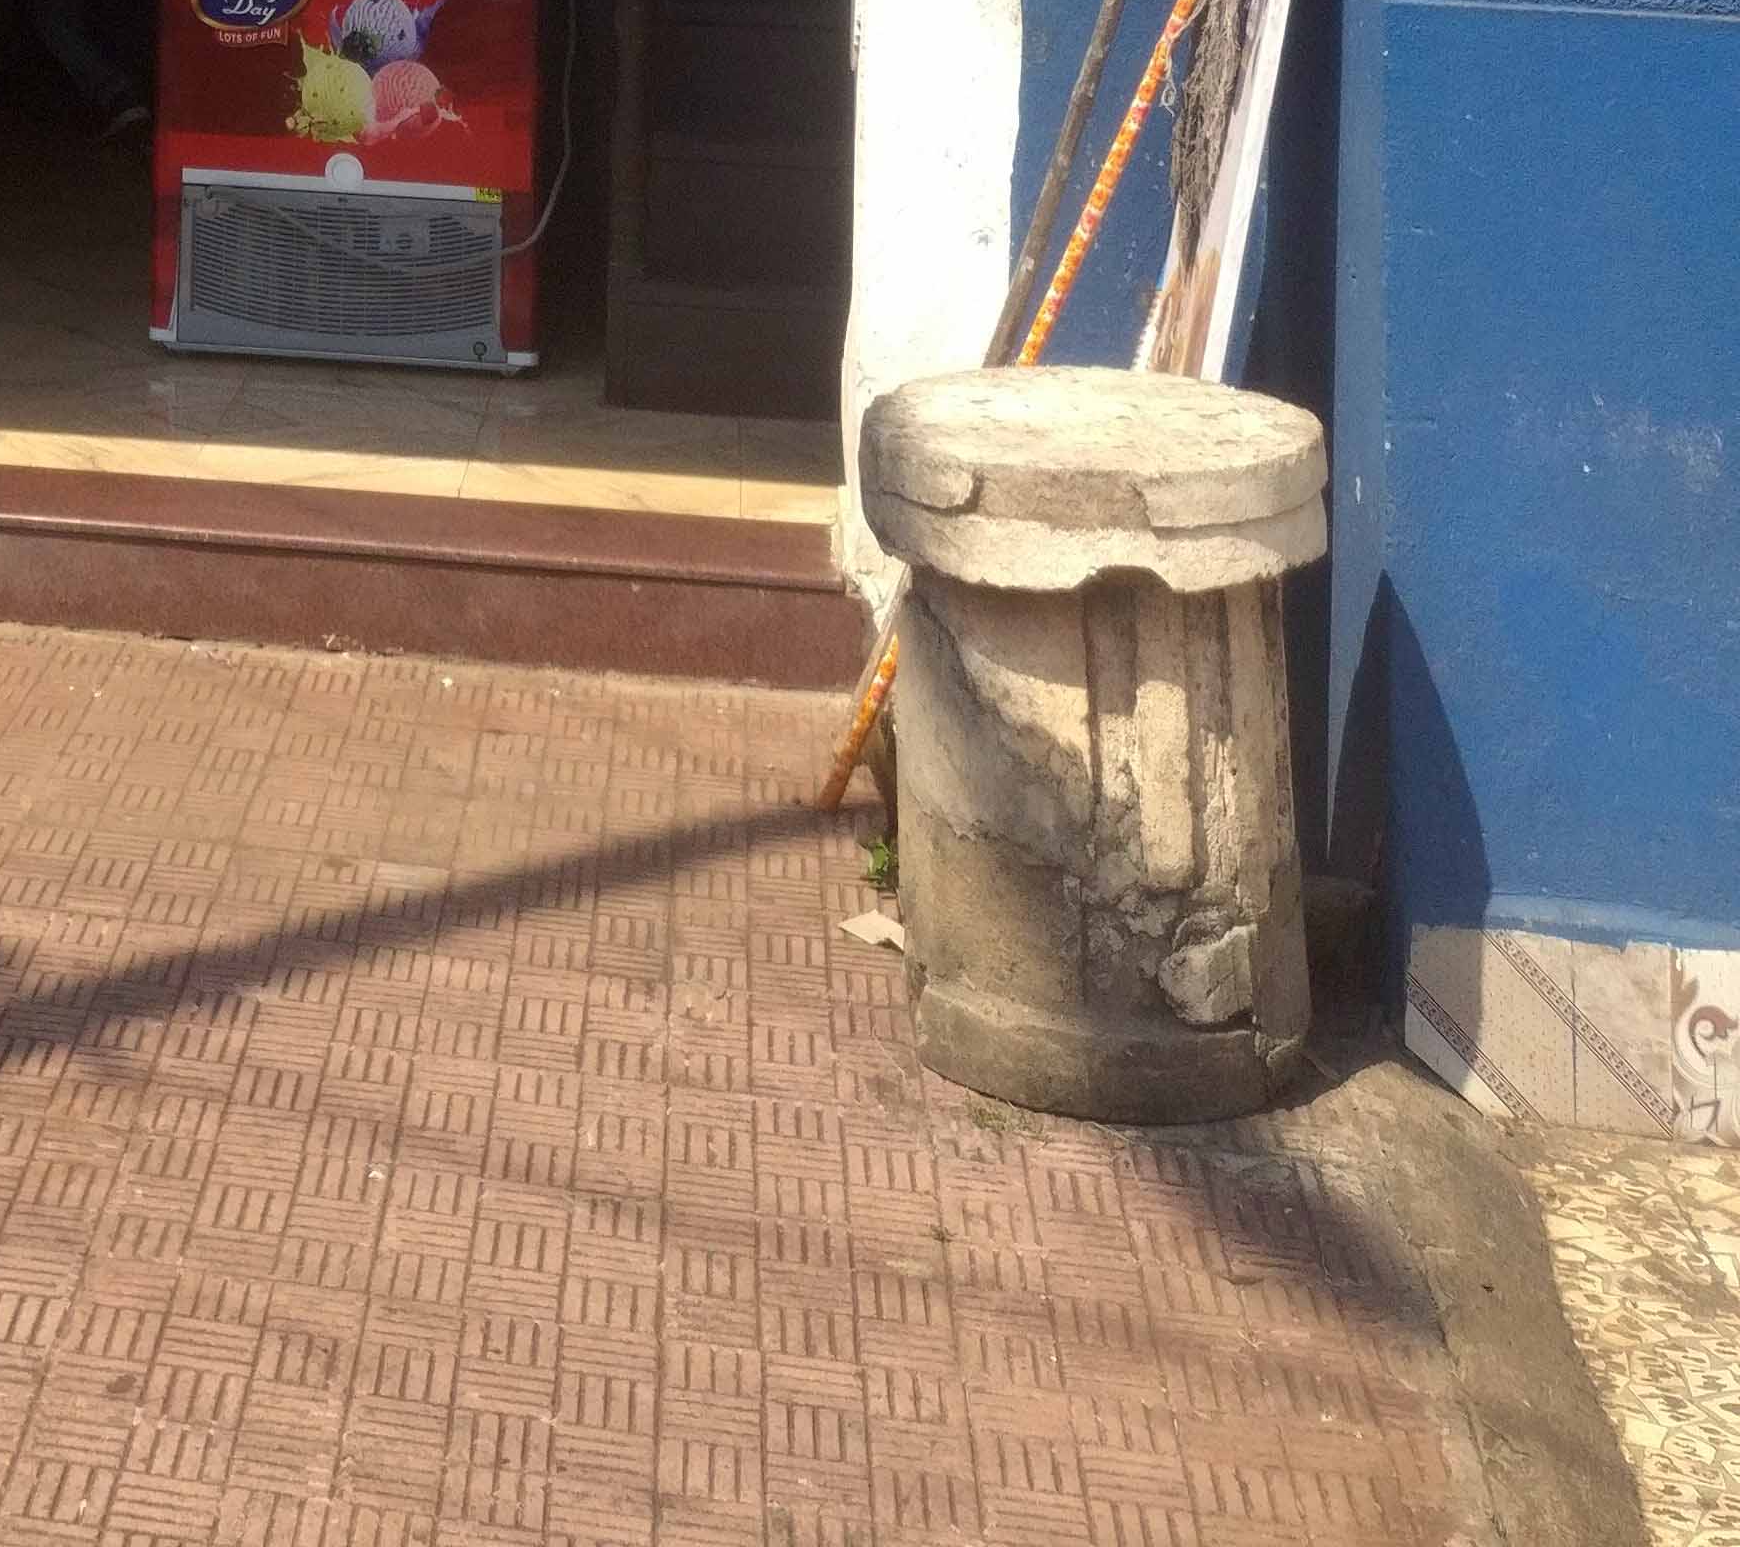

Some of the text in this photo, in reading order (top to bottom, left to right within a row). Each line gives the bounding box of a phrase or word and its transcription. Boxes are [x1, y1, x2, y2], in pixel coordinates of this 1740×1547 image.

[219, 28, 281, 44] LOTS OF FUN
